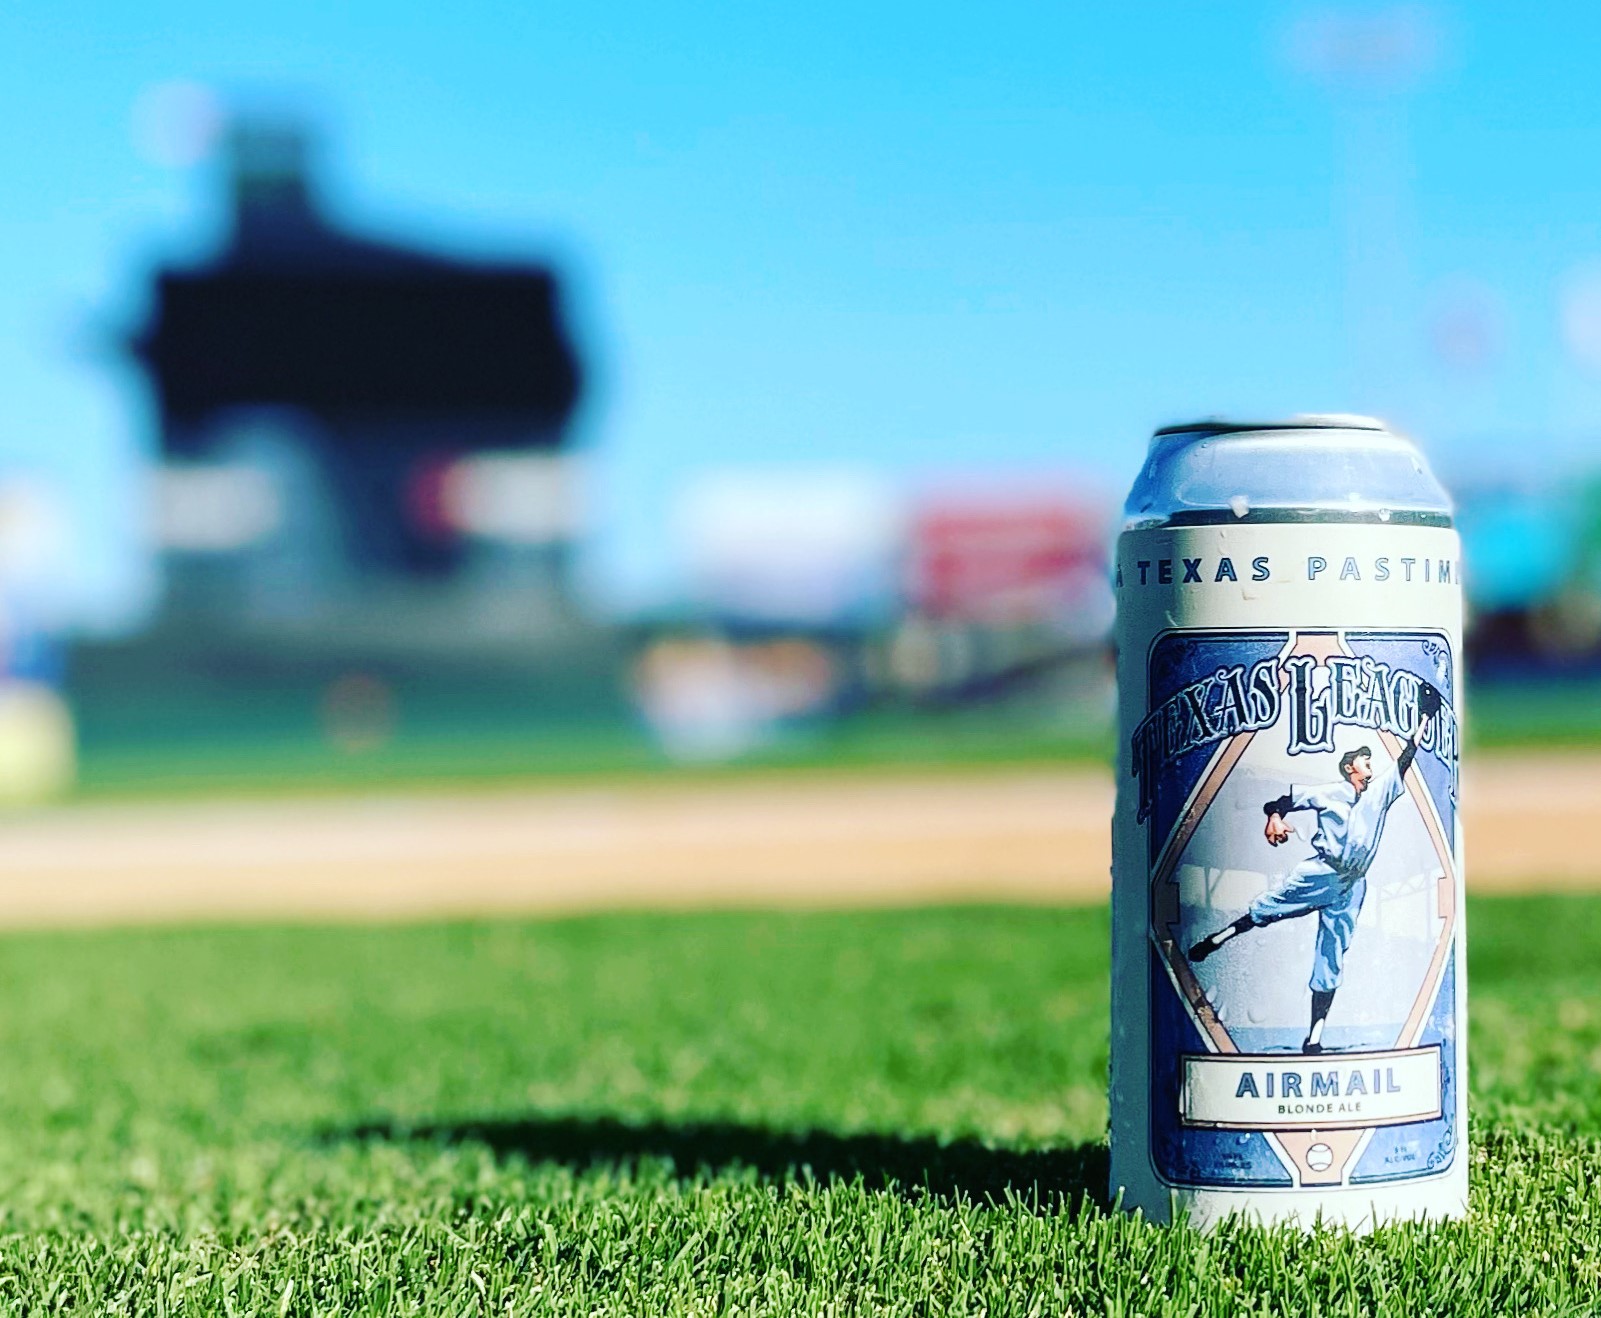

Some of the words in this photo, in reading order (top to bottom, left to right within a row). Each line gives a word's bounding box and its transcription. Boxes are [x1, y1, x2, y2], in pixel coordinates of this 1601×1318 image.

[1137, 556, 1271, 586] TEXAS
[1131, 663, 1281, 825] TEXAS
[1235, 1067, 1401, 1099] AIRMAIL
[1277, 1103, 1333, 1115] BLONDE
[1338, 1101, 1362, 1113] ALE
